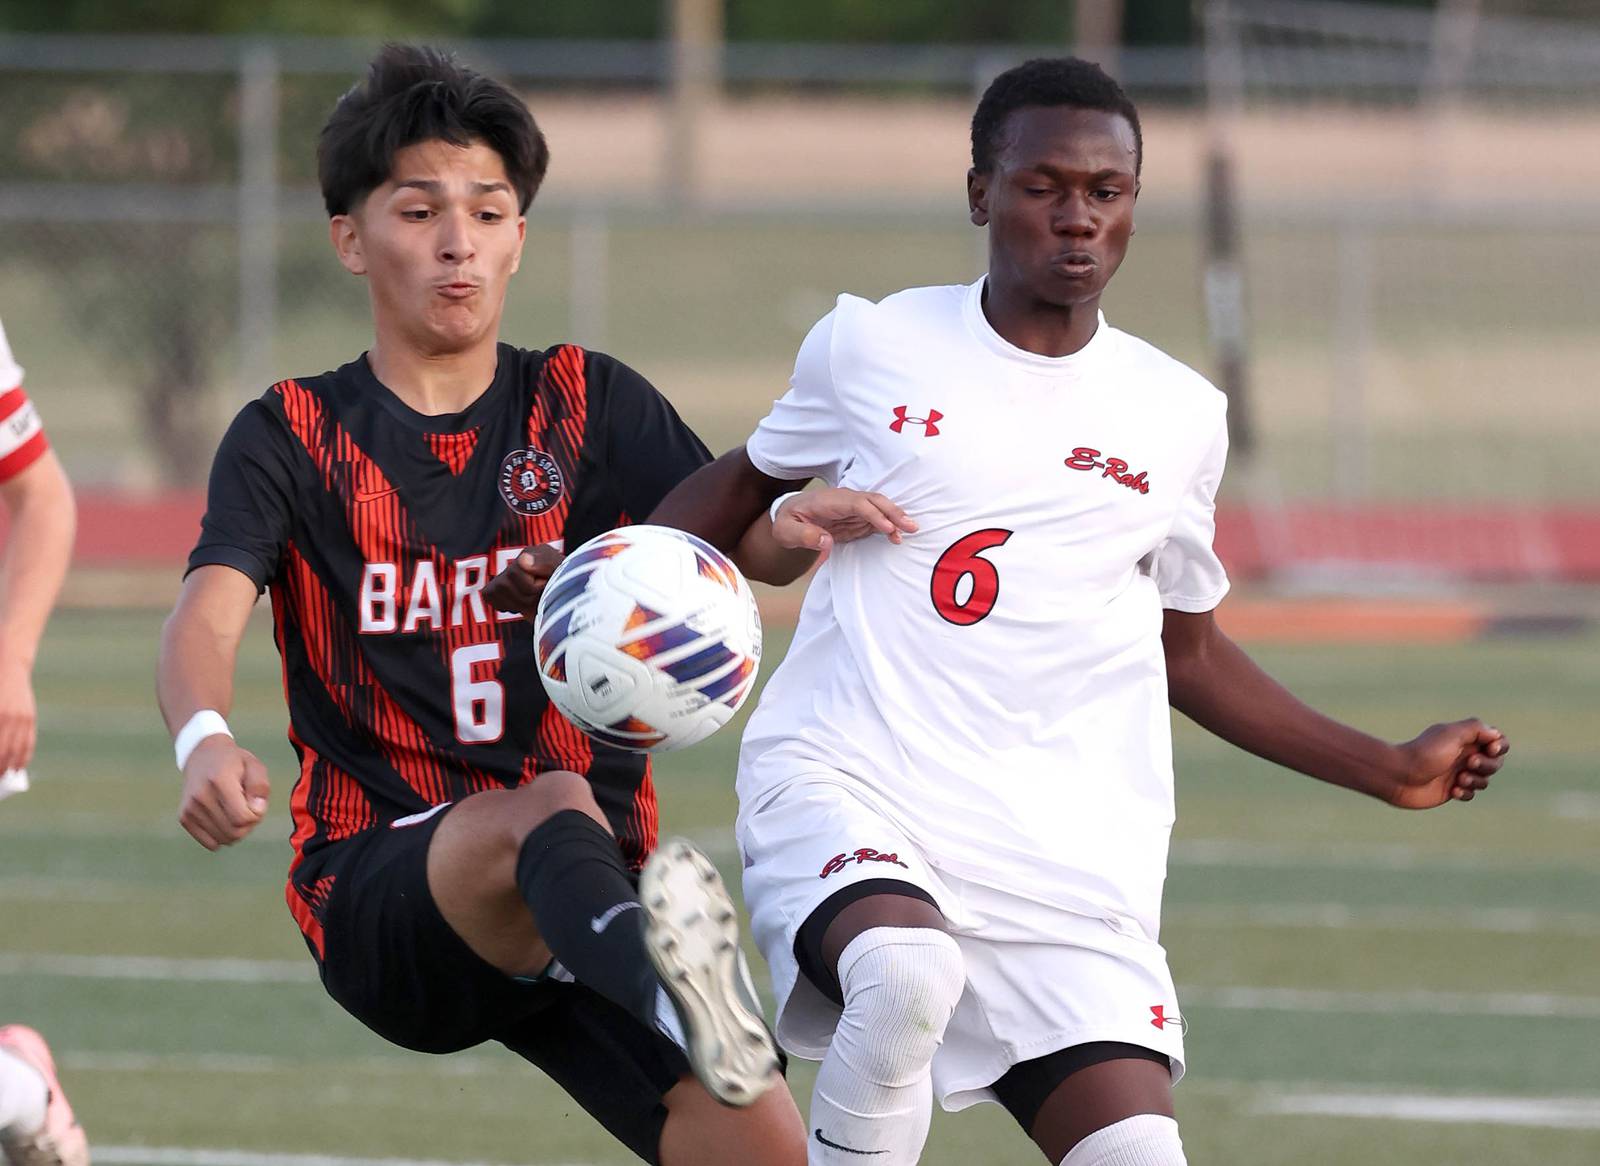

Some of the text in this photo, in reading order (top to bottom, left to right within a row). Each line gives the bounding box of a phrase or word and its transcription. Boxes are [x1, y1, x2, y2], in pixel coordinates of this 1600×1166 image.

[538, 459, 560, 494] SOCCER
[1064, 447, 1149, 494] E-Rabs
[358, 539, 565, 634] BAR
[930, 527, 1014, 627] 6
[451, 642, 505, 744] 6
